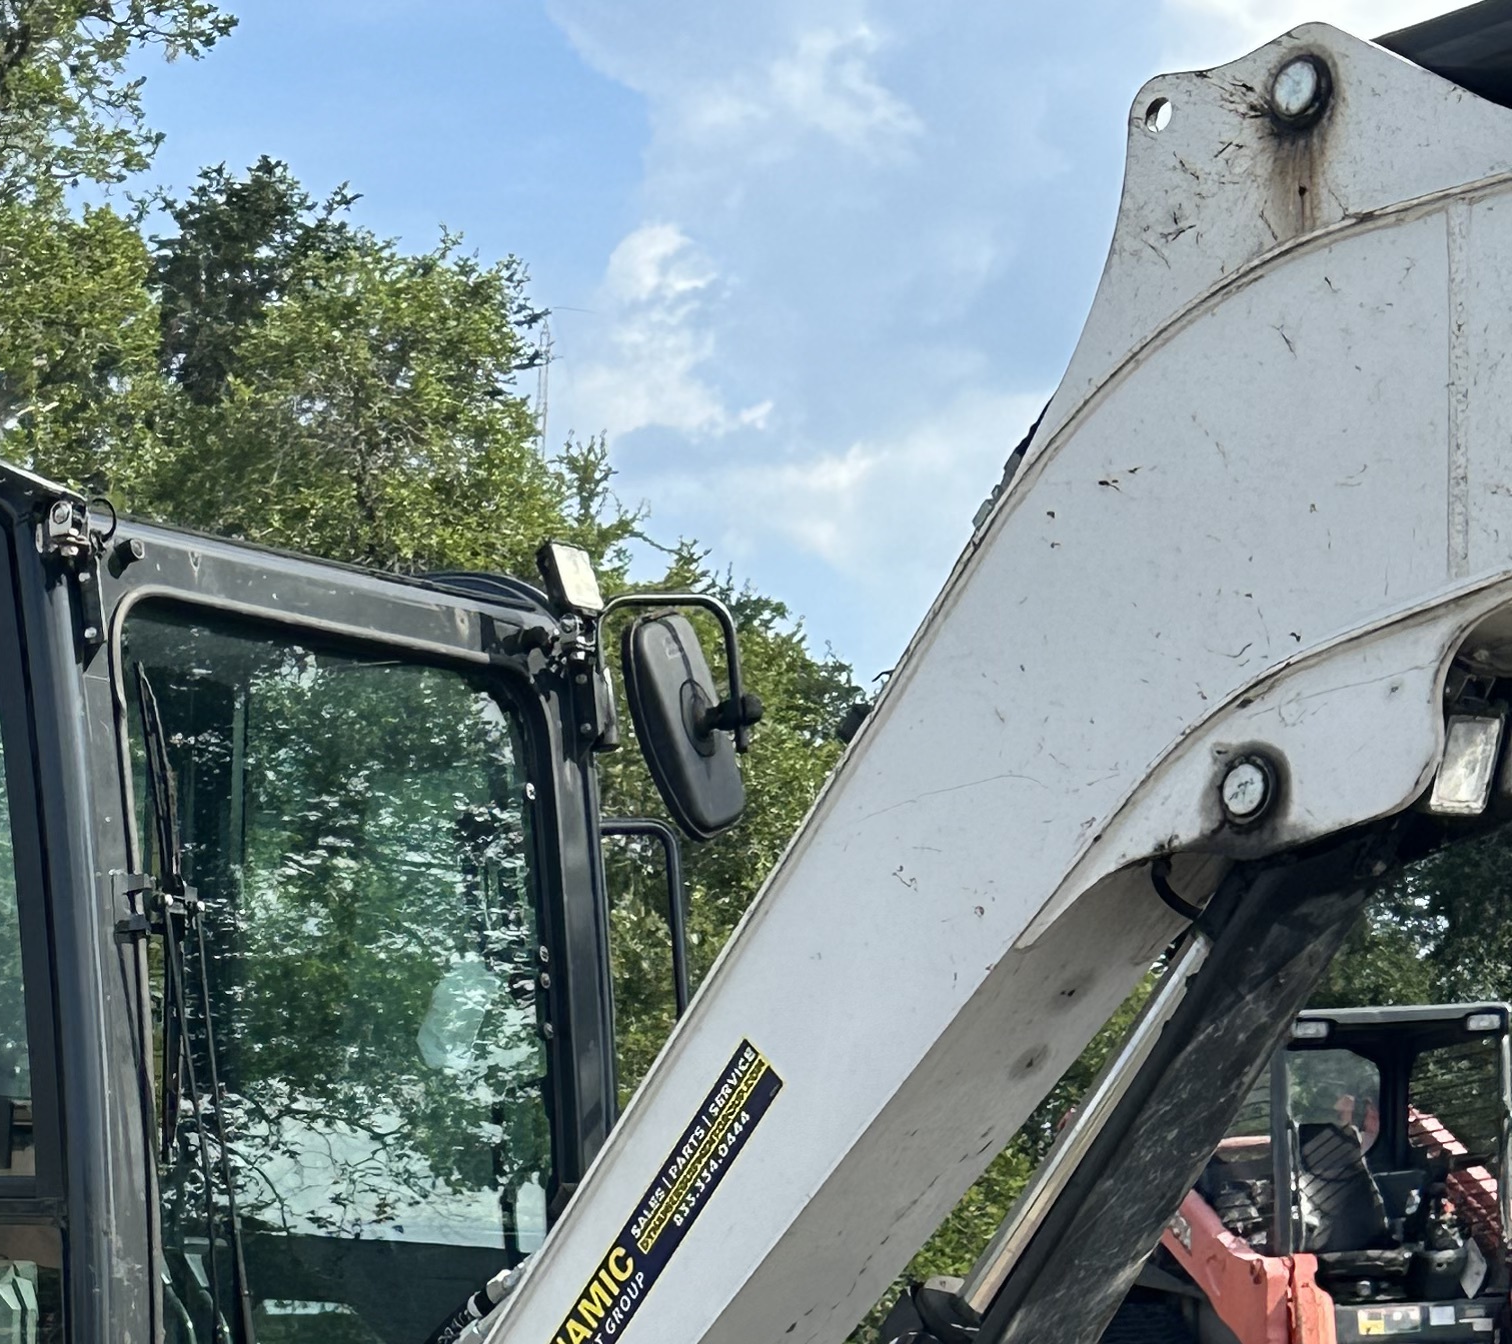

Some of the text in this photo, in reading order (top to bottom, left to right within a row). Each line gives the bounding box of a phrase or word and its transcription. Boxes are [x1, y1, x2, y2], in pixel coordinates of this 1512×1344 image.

[630, 1187, 666, 1239] SALES
[668, 1125, 706, 1180] PARTS
[708, 1046, 756, 1117] SERVICE
[605, 1271, 645, 1335] GROUP
